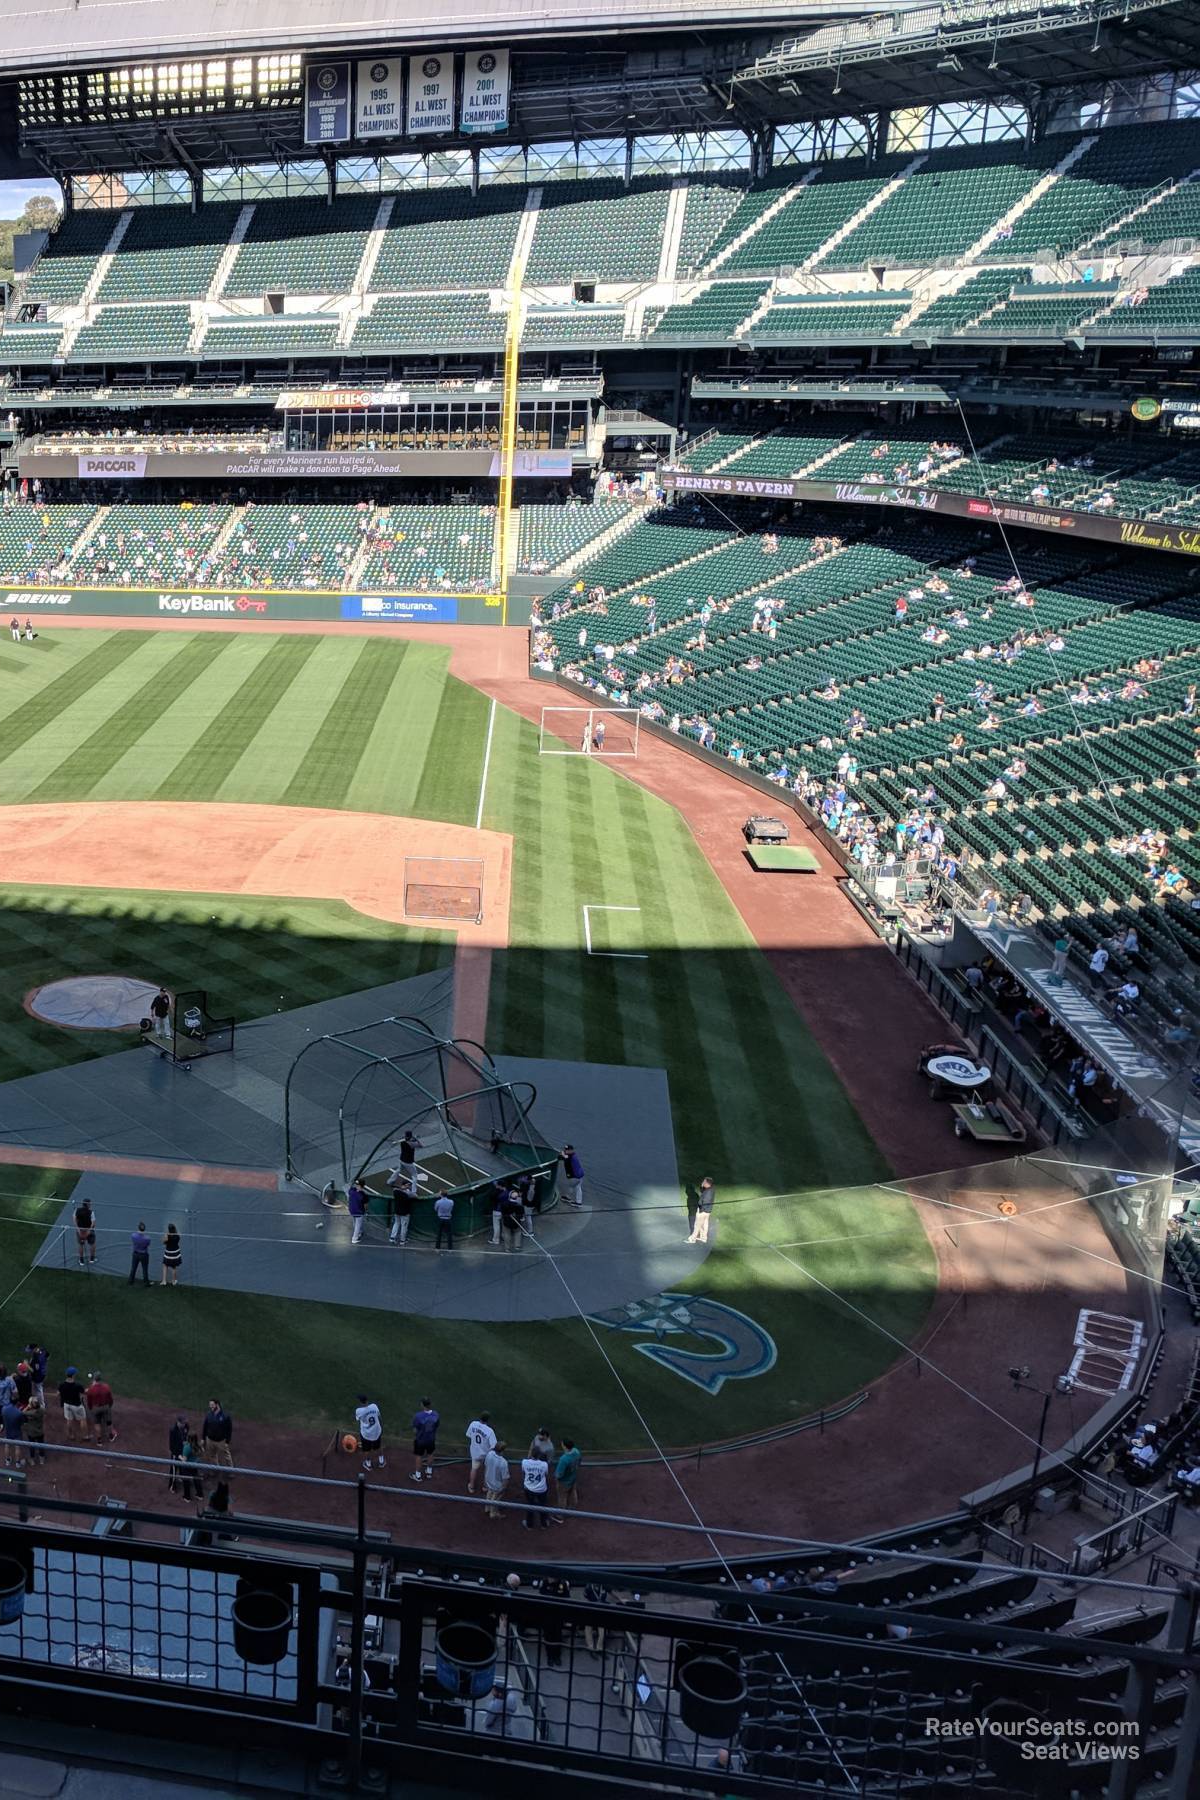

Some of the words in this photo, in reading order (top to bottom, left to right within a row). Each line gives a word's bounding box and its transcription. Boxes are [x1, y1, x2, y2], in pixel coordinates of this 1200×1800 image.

[422, 84, 440, 96] 1997
[476, 79, 495, 91] 2001
[370, 88, 388, 100] 1995
[482, 93, 502, 106] WEST
[375, 103, 395, 115] WEST
[427, 98, 447, 111] WEST
[410, 115, 451, 129] CHAMPIONS
[464, 109, 506, 123] CHAMPIONS
[358, 118, 399, 132] CHAMPIONS
[87, 461, 136, 472] PACCAR
[249, 456, 263, 465] For
[263, 457, 285, 466] every
[286, 456, 323, 465] Mariners
[324, 457, 338, 465] run
[339, 456, 366, 465] batted
[367, 456, 377, 465] in,
[226, 466, 260, 474] PACCAR
[276, 465, 299, 473] make
[306, 465, 341, 473] donation
[351, 465, 373, 475] Page
[675, 476, 732, 491] HENRY'S
[736, 481, 795, 495] TAVERN
[835, 484, 878, 502] Welcome
[879, 491, 889, 503] to
[890, 488, 917, 506] Safeco
[916, 491, 939, 510] Field
[1120, 522, 1161, 546] Welcome
[1162, 534, 1172, 548] to
[5, 593, 72, 605] BOEING
[158, 594, 236, 613] KeyBank
